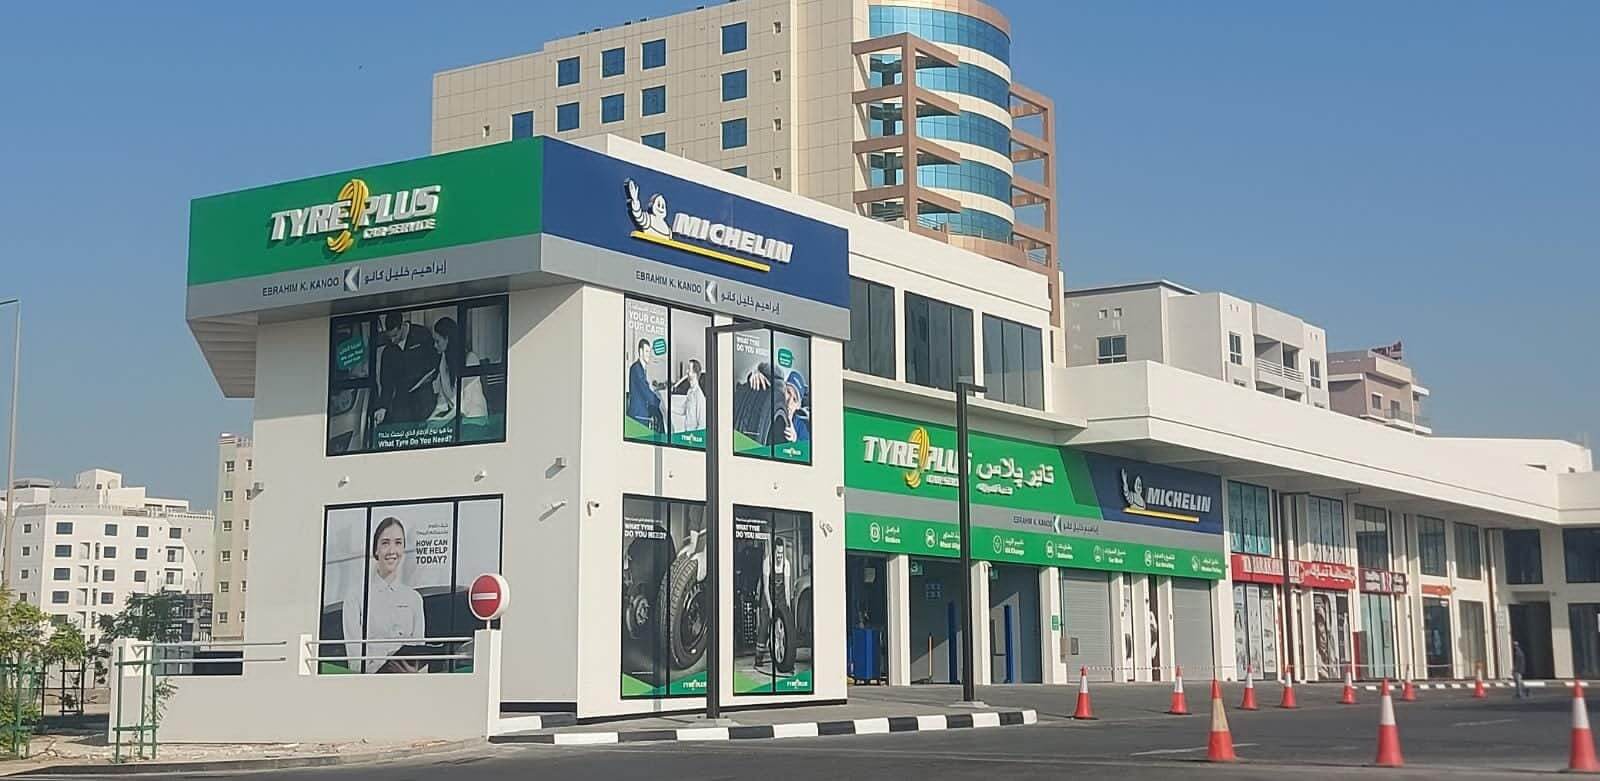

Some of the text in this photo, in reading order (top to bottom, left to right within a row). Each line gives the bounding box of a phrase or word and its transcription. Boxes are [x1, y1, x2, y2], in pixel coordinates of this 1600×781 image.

[673, 213, 793, 264] MICHELIN
[364, 259, 447, 284] إبراهيم خليل كانو
[262, 277, 340, 296] EBRAHIM K. KANOO
[635, 270, 702, 294] EBRAHIM K. KANOO
[721, 291, 736, 302] كانو
[737, 293, 754, 307] خليل
[629, 310, 649, 320] YOUR
[629, 321, 644, 330] OUR
[378, 435, 453, 448] What Tyre Do You Need?
[1147, 487, 1212, 513] MICHELIN
[635, 530, 647, 538] YOU
[736, 530, 744, 538] DO
[744, 531, 754, 539] YOU
[430, 546, 448, 554] HELP
[416, 555, 448, 565] TODAY?
